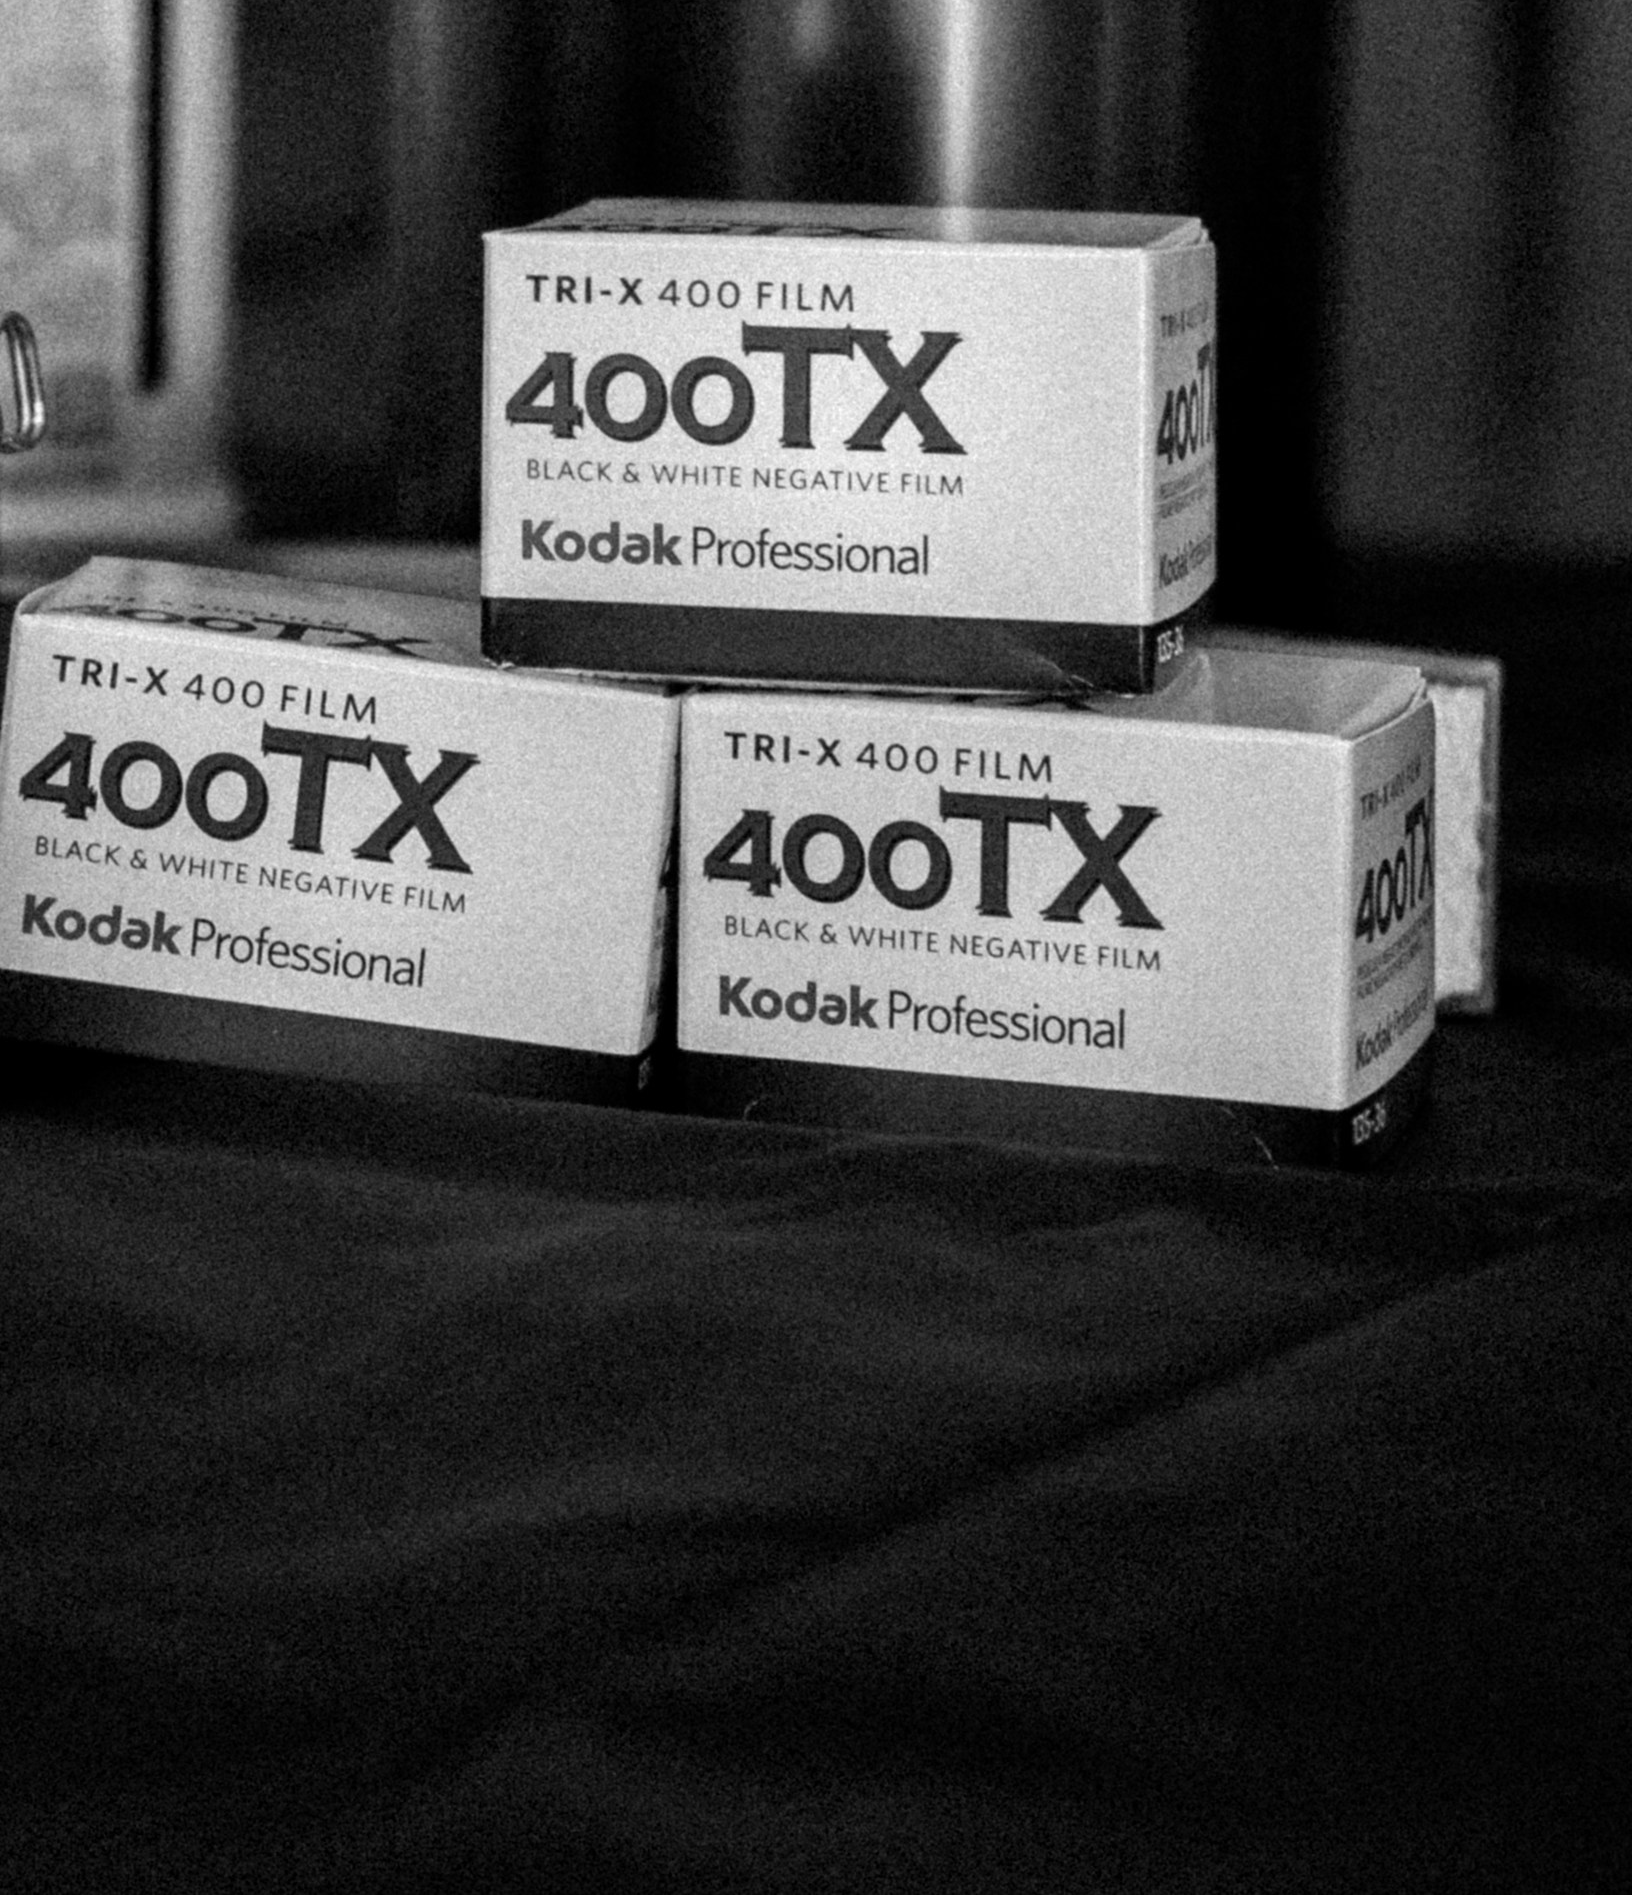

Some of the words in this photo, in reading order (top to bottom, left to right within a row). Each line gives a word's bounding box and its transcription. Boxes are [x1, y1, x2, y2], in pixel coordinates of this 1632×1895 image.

[525, 273, 643, 306] TRI-X
[657, 278, 742, 310] 400
[756, 280, 855, 313] FILM
[505, 321, 967, 456] 400TX
[525, 457, 612, 483] BLACK
[621, 461, 641, 485] &
[650, 463, 741, 488] WHITE
[752, 467, 889, 494] NEGATIVE
[900, 472, 964, 496] FILM
[521, 519, 682, 567] Kodak
[691, 525, 930, 576] Professional
[52, 653, 168, 697] TRI-X
[182, 673, 266, 710] 400
[279, 684, 377, 723] FILM
[724, 731, 842, 768] TRI-X
[855, 741, 939, 775] 400
[954, 747, 1053, 783] FILM
[18, 722, 480, 875] 400TX
[34, 834, 121, 866] BLACK
[129, 848, 148, 871] &
[158, 852, 249, 885] WHITE
[258, 865, 394, 905] NEGATIVE
[403, 885, 467, 914] FILM
[703, 786, 1164, 931] 400TX
[21, 893, 182, 955] Kodak
[190, 916, 427, 988] Professional
[723, 914, 809, 942] BLACK
[818, 922, 838, 945] &
[847, 925, 938, 954] WHITE
[948, 933, 1086, 966] NEGATIVE
[1097, 945, 1162, 972] FILM
[718, 974, 878, 1029] Kodak
[887, 988, 1126, 1050] Professional
